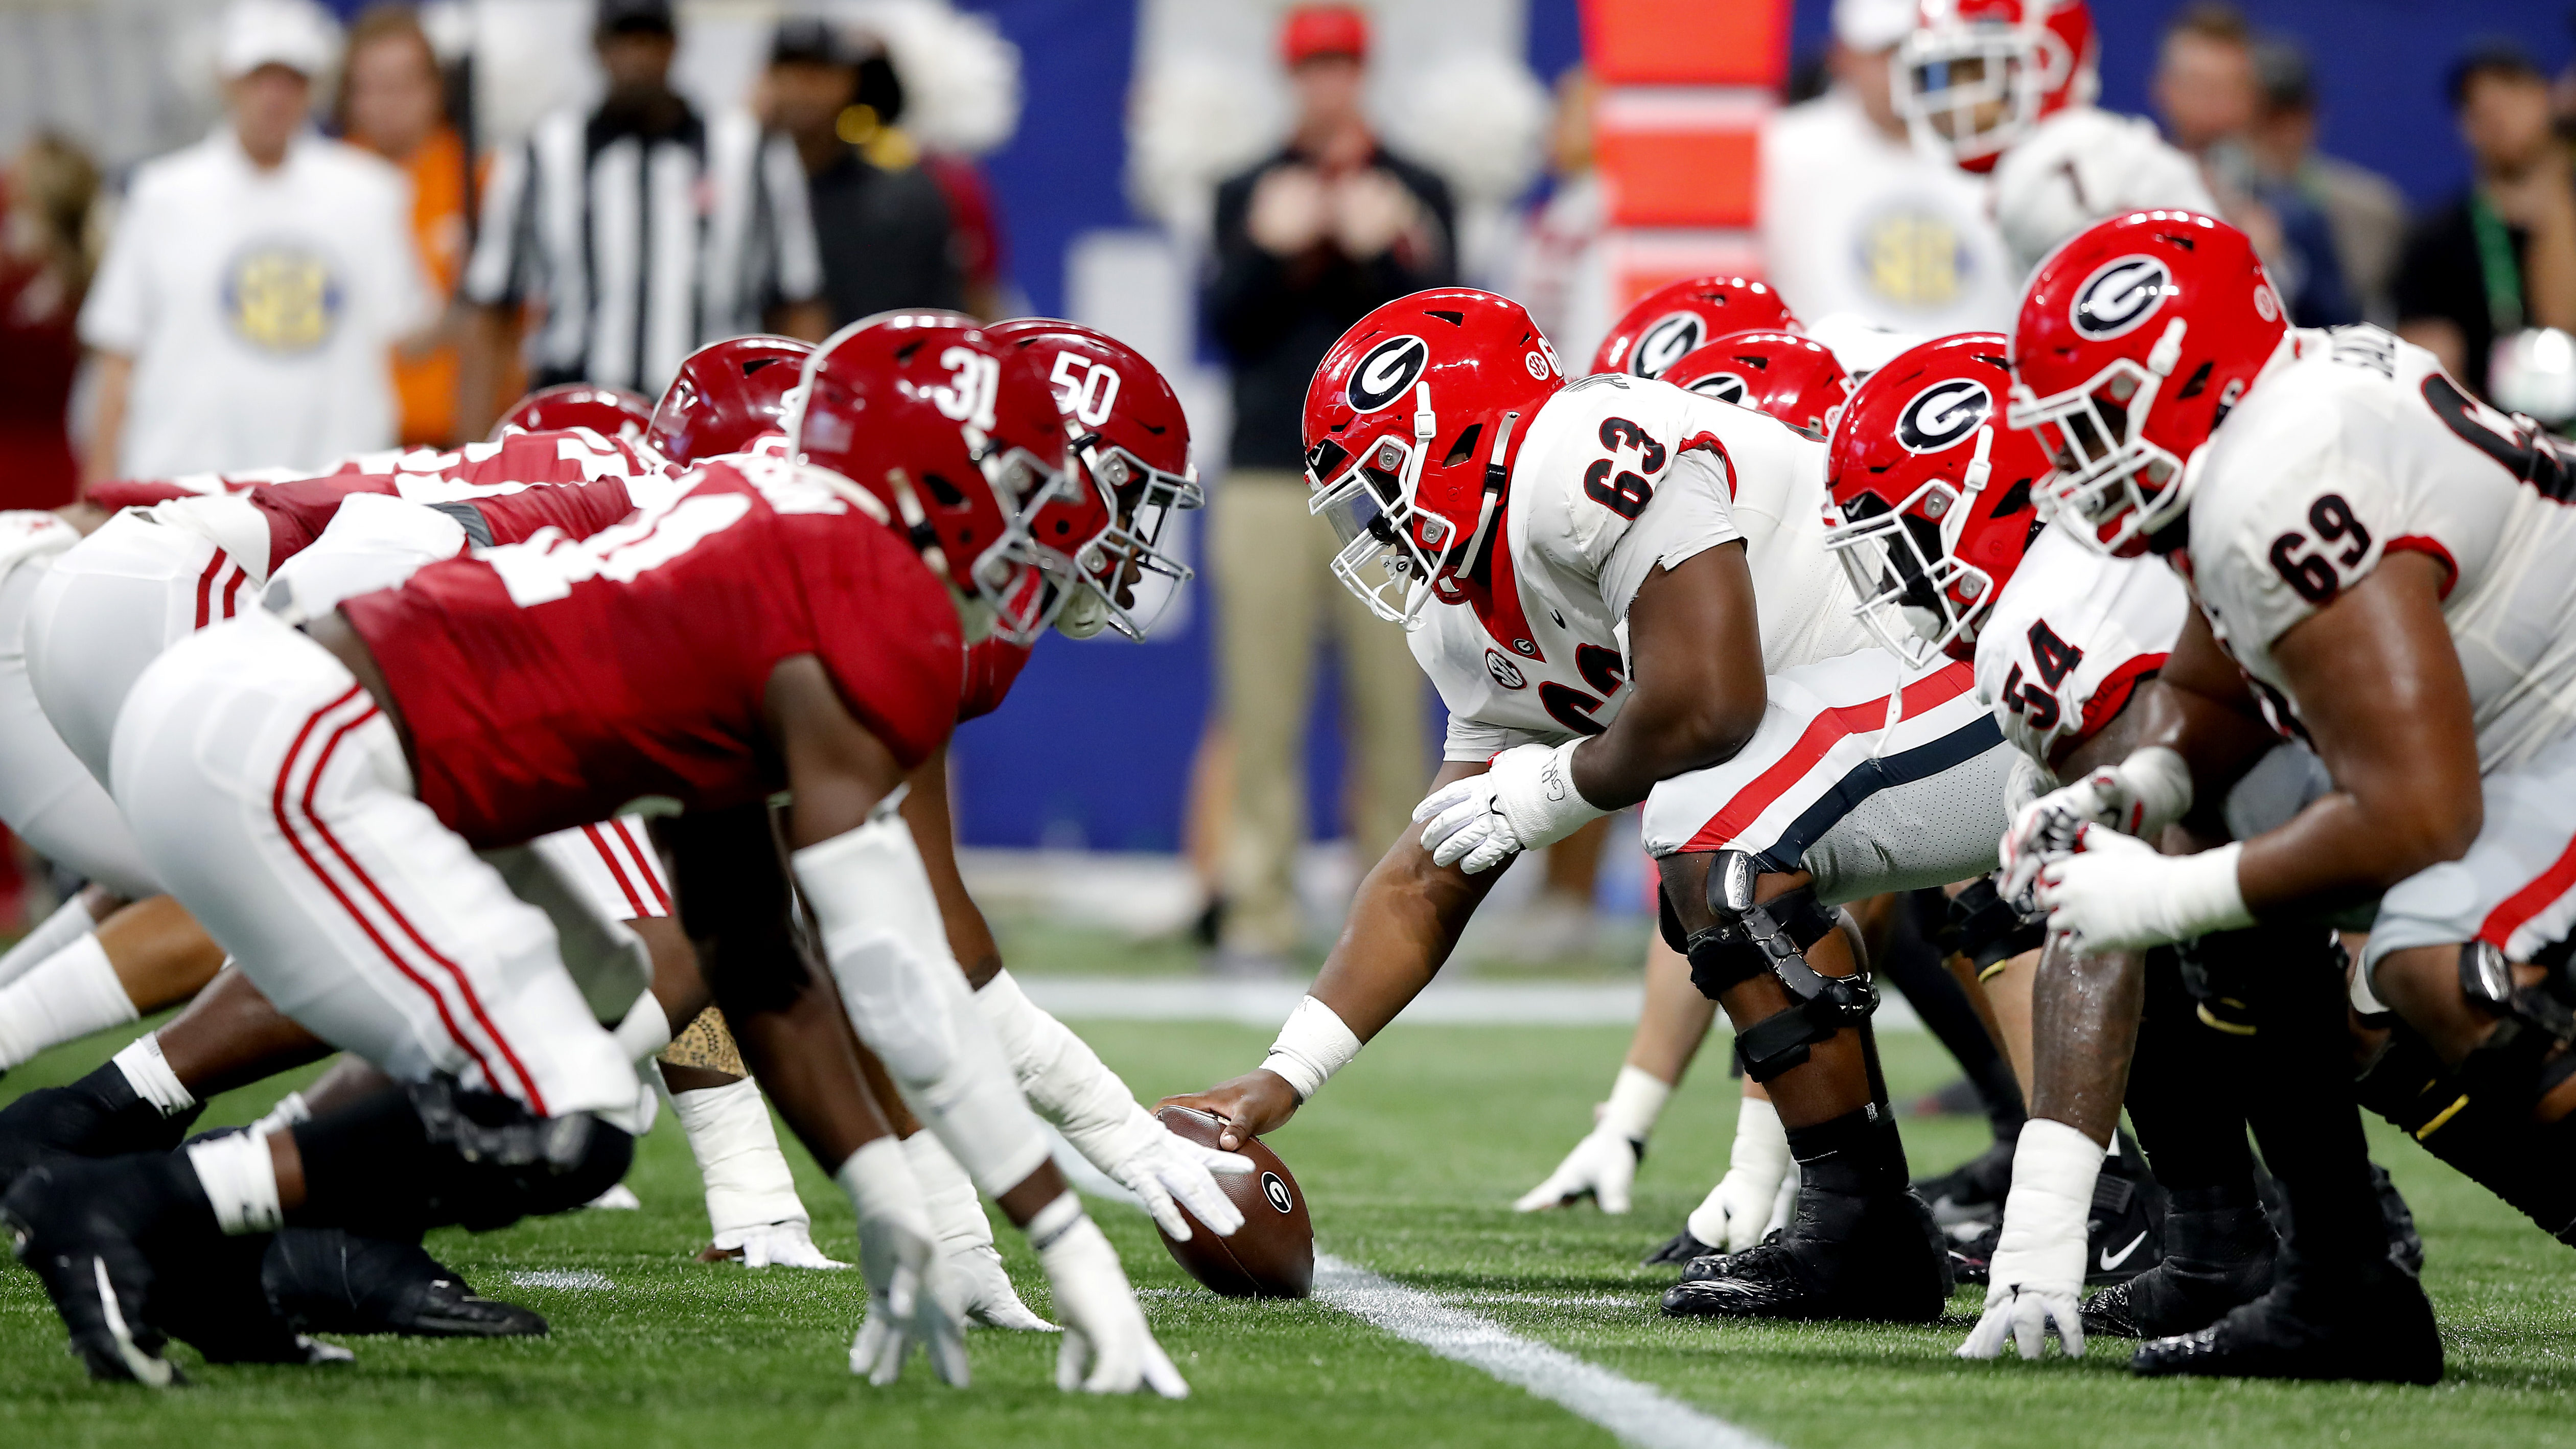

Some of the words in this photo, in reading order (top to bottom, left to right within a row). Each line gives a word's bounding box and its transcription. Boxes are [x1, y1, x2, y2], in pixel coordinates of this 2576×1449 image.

[934, 345, 1001, 432] 31
[1049, 350, 1121, 427] 50
[1347, 336, 1427, 412] G
[1584, 416, 1666, 520] 63
[2270, 494, 2371, 603] 69
[2002, 618, 2084, 731] 54
